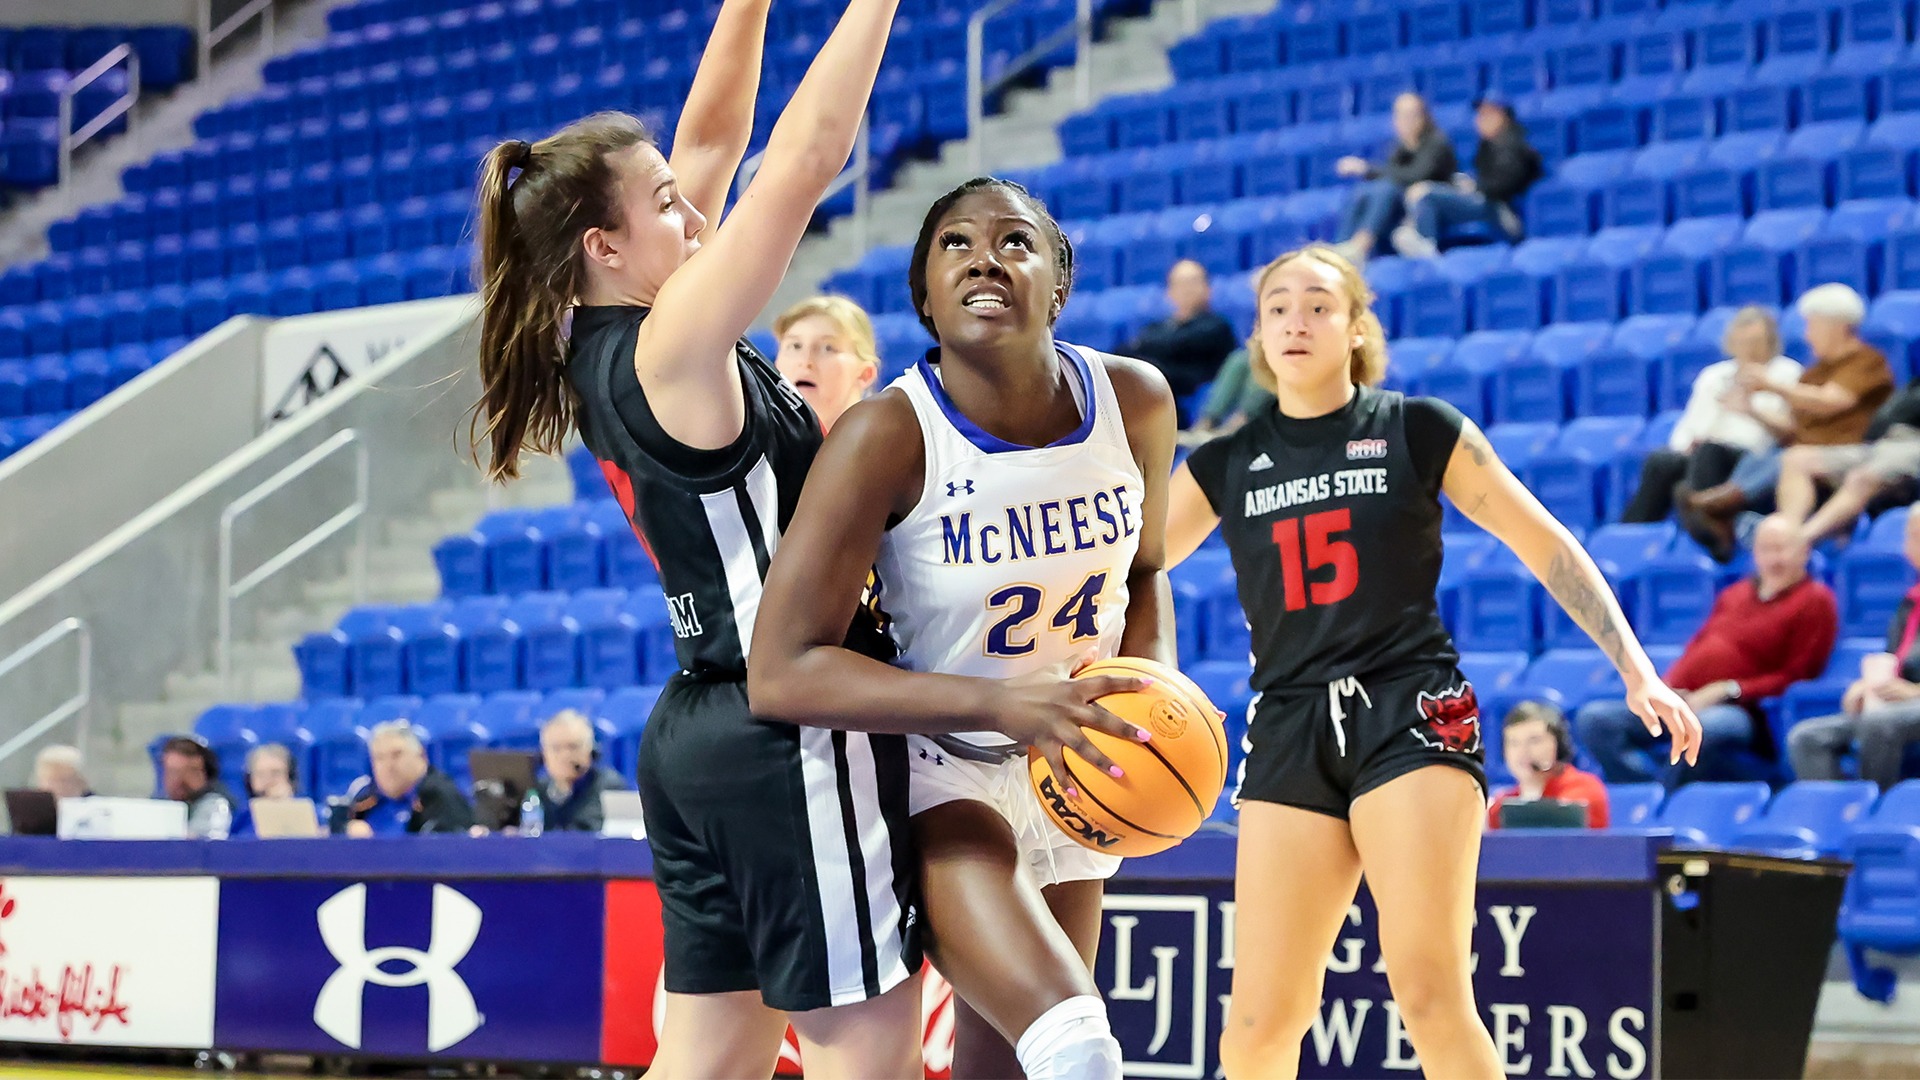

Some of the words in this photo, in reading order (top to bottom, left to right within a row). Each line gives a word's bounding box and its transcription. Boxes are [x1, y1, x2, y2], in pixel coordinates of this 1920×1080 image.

[1244, 474, 1330, 518] ARKANSAS
[1334, 468, 1388, 497] STATE
[1272, 508, 1359, 612] 15
[983, 568, 1111, 659] 24
[1039, 774, 1120, 848] NCAA
